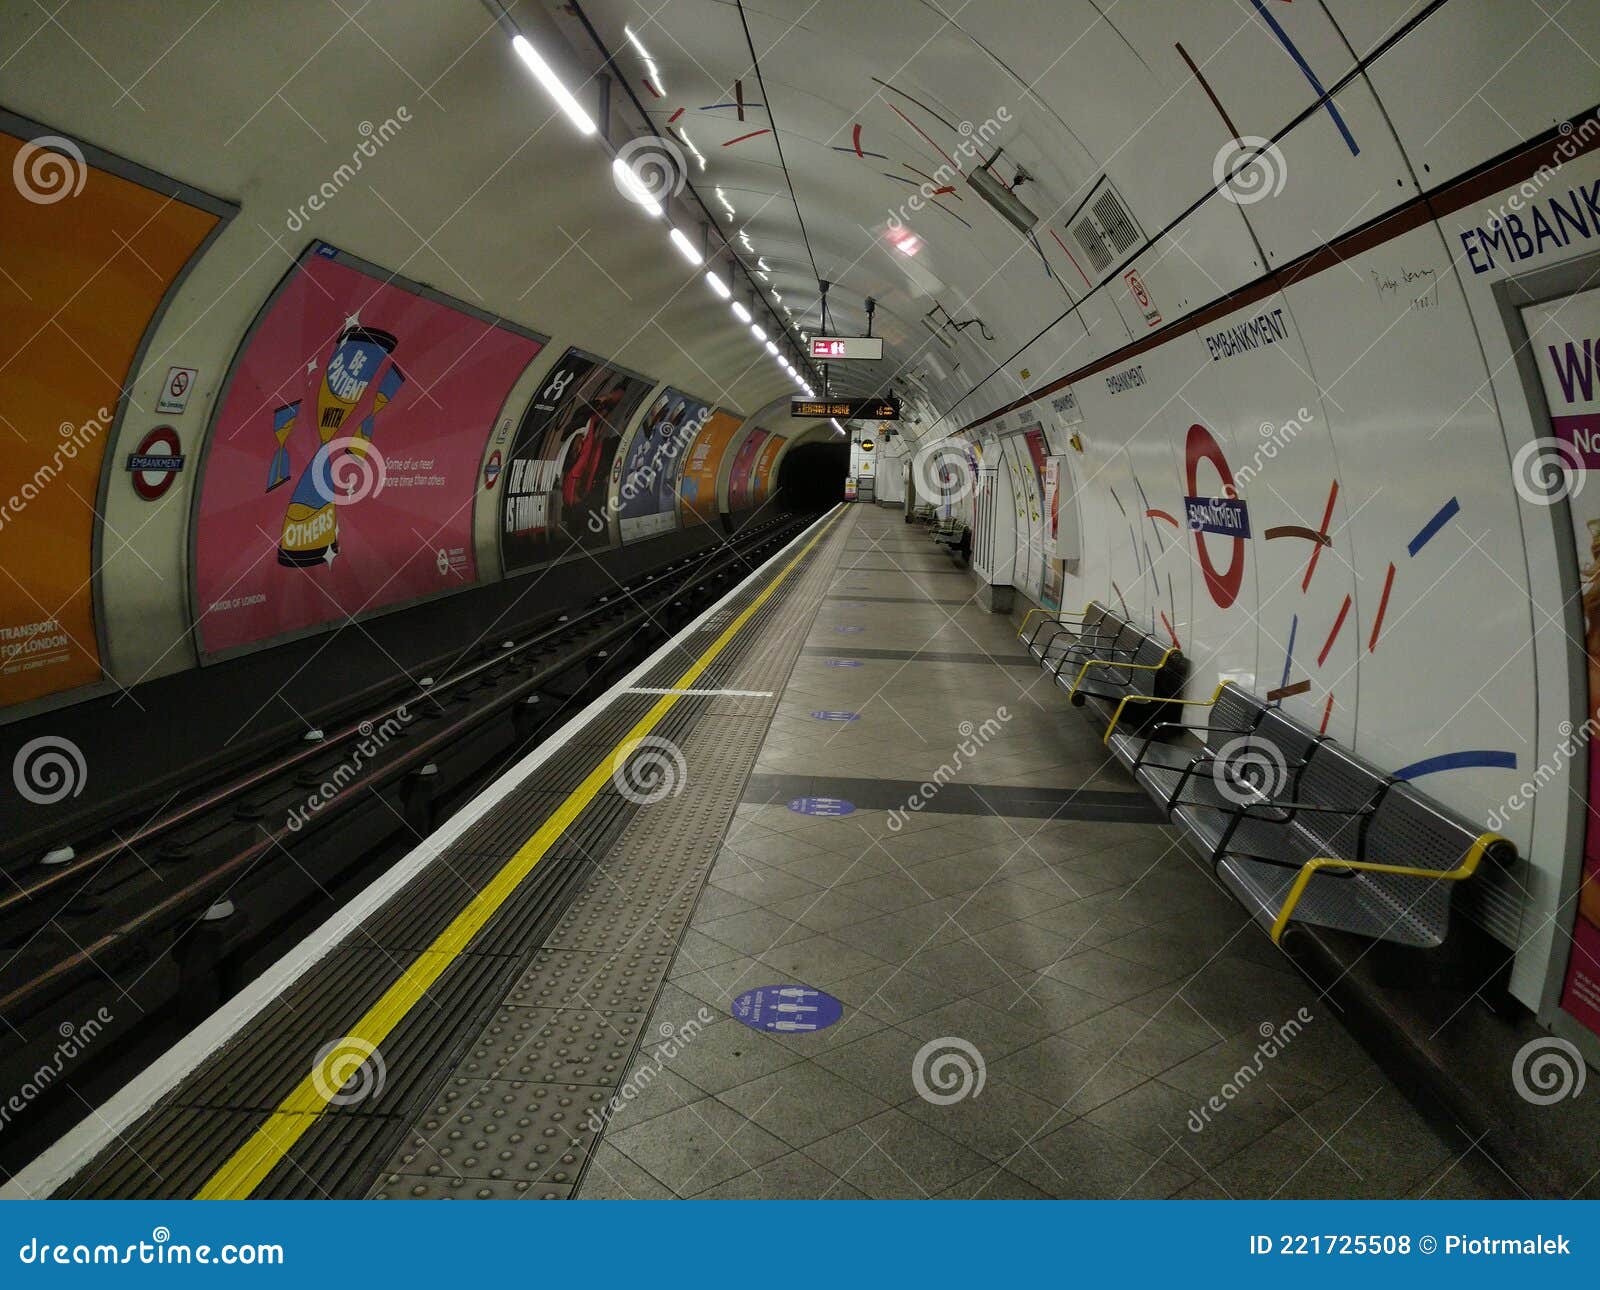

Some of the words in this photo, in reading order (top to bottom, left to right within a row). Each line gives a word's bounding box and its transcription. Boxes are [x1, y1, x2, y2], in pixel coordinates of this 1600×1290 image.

[1460, 180, 1600, 274] EMBANK
[1206, 309, 1288, 361] EMBANKMENT
[349, 349, 368, 376] BE
[328, 353, 369, 401] PATIENT
[321, 407, 345, 428] WITH
[131, 457, 182, 468] EMBANKMENT
[285, 508, 334, 547] OTHERS
[0, 619, 59, 640] TRANSPORT
[1, 642, 22, 657] FOR
[25, 635, 68, 653] LONDON
